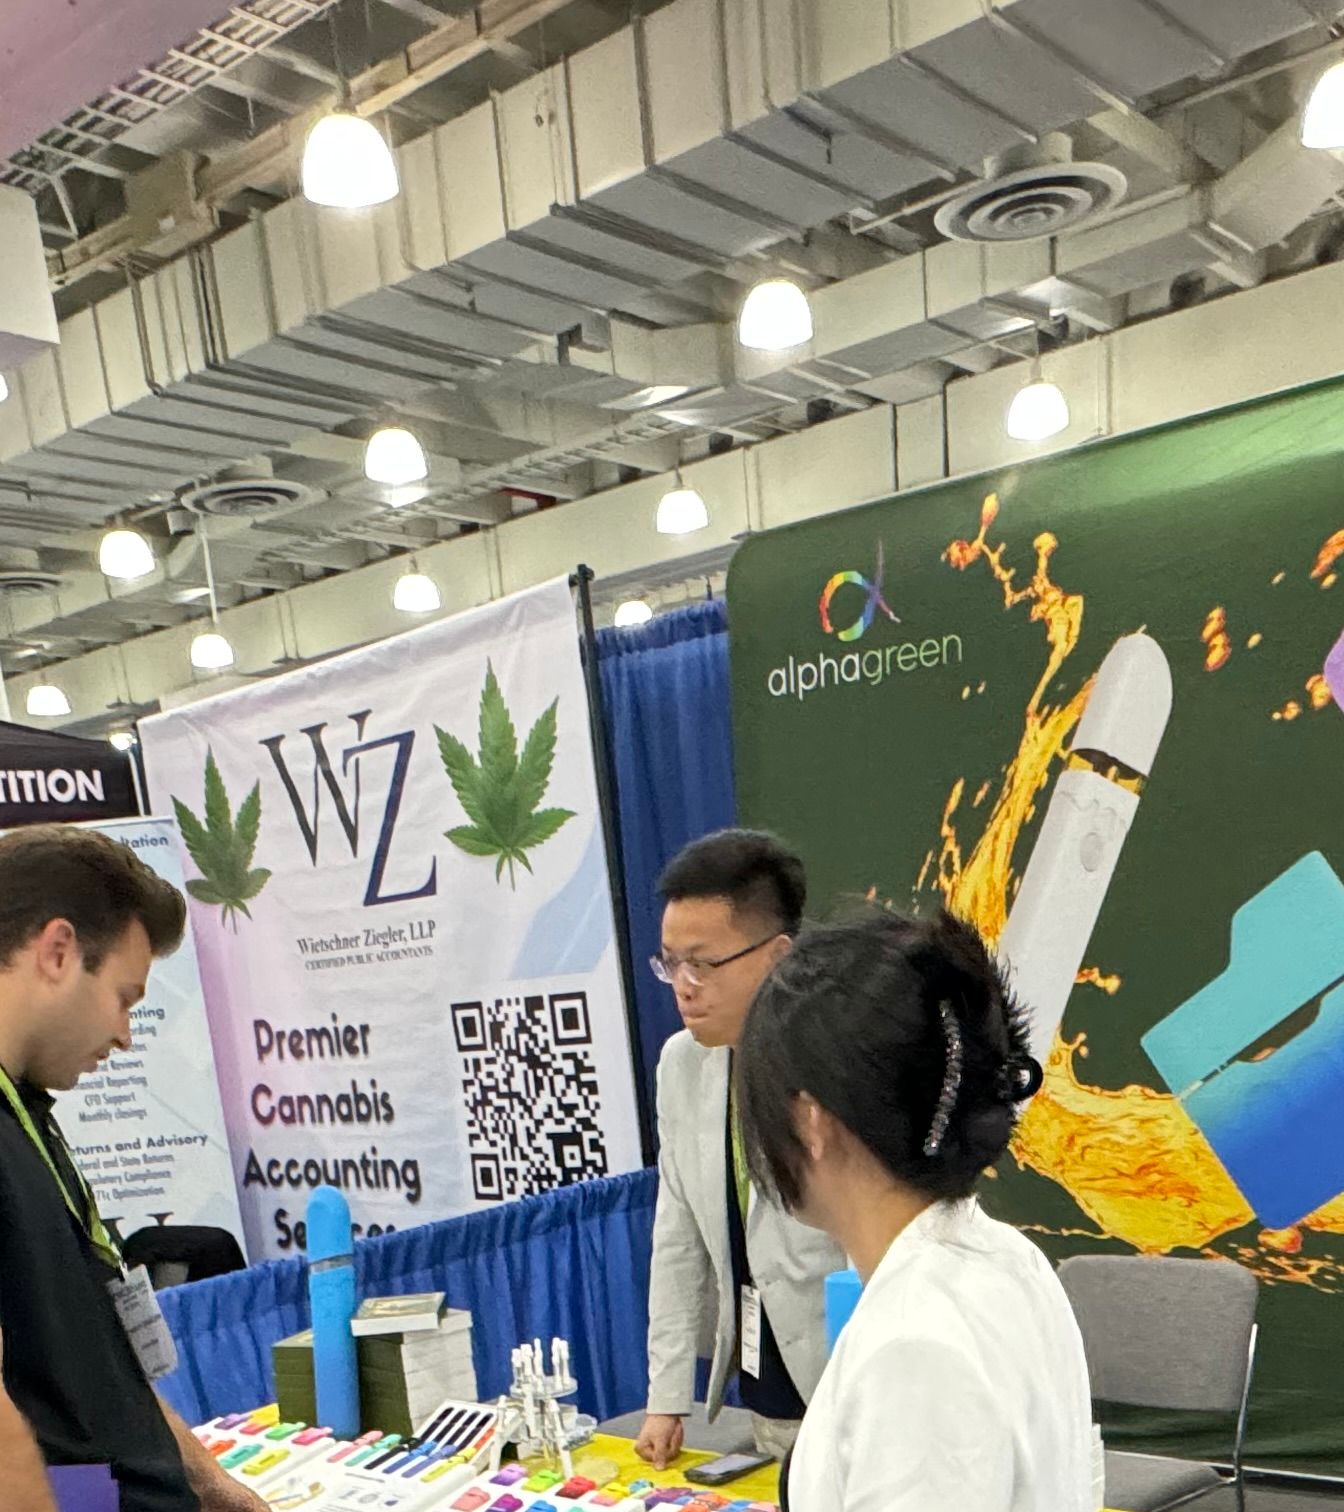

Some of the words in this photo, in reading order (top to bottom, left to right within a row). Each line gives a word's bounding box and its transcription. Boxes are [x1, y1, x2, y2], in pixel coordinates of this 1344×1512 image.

[768, 633, 962, 700] alphagreen
[296, 933, 361, 955] Wietschner
[363, 925, 407, 949] Ziegler,
[408, 919, 437, 941] LLP
[375, 944, 434, 963] ACCOUNTANTS
[253, 1012, 371, 1062] Premier
[250, 1078, 396, 1126] Cannabis
[115, 1138, 142, 1152] and
[146, 1133, 208, 1149] Advisory
[242, 1145, 422, 1204] Accounting
